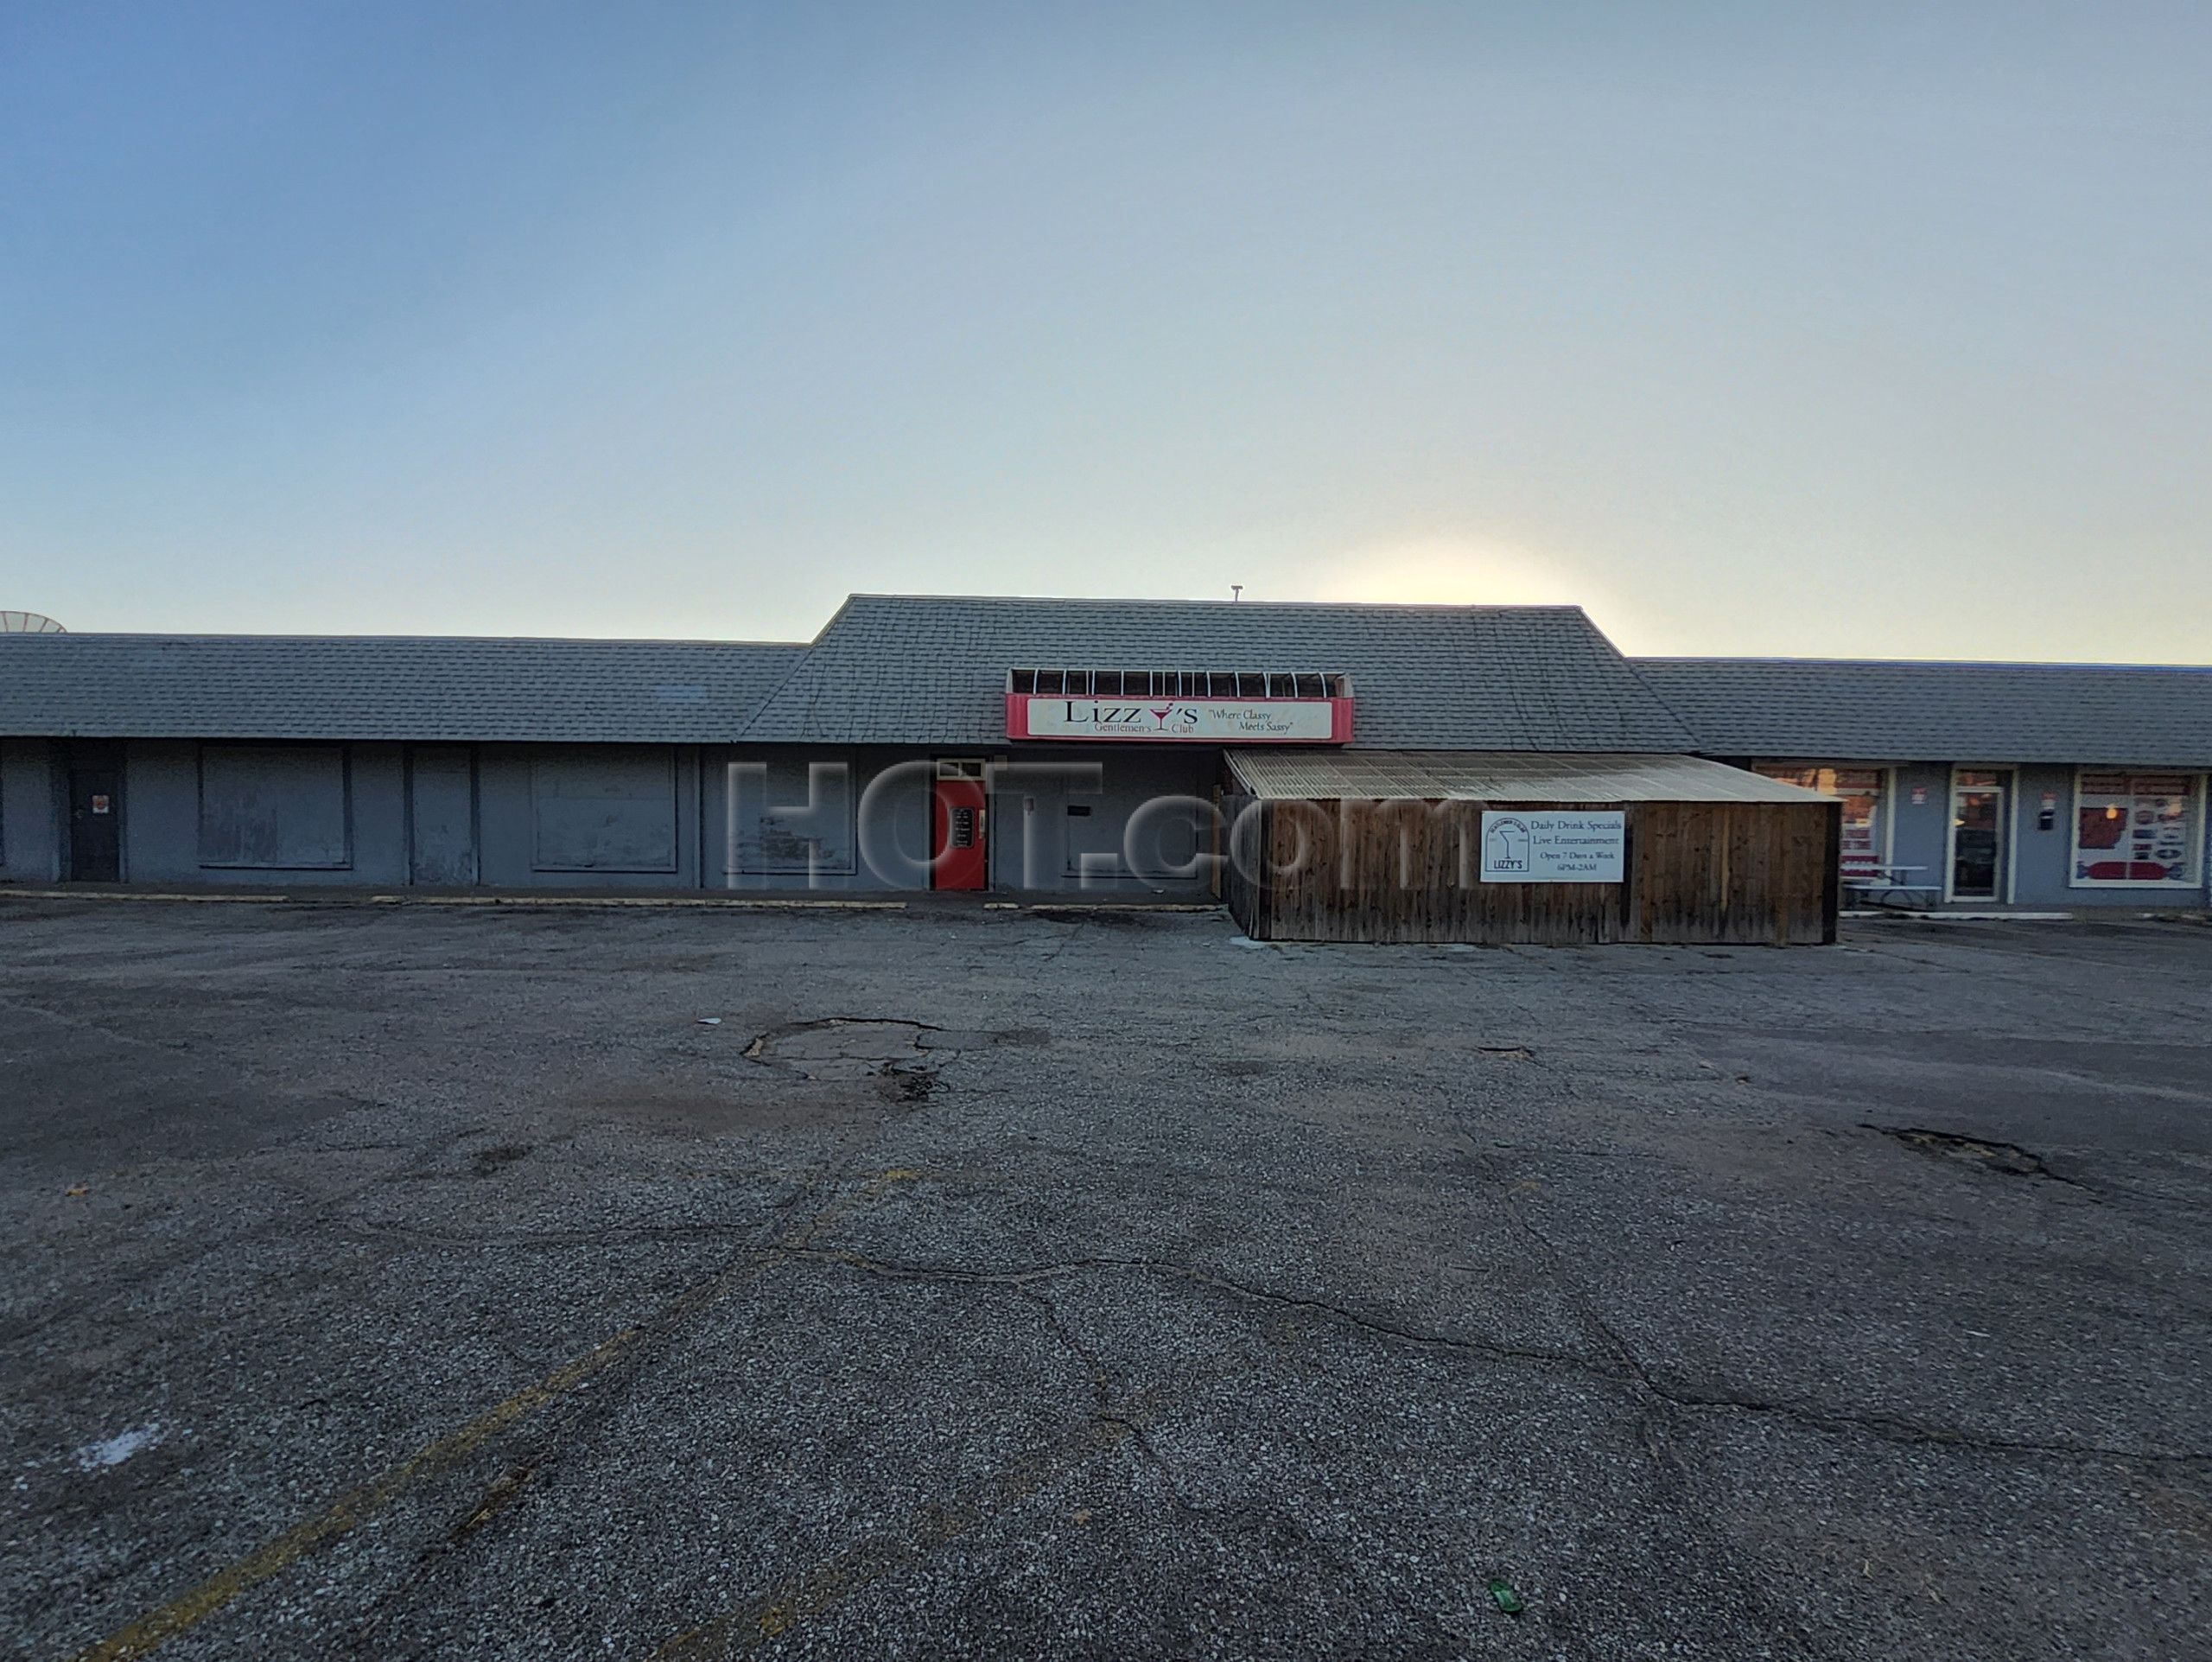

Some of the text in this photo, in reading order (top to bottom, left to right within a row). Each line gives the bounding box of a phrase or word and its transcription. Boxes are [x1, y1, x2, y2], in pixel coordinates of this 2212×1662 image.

[1243, 709, 1272, 722] Classy
[1171, 723, 1194, 733] Club
[1238, 722, 1264, 731] Meets
[1530, 820, 1622, 832] Daily Drink Specials
[1533, 836, 1552, 844] Live
[1554, 835, 1619, 845] Entertainment
[1540, 851, 1560, 861] Open
[1494, 860, 1523, 869] LIZZY'S
